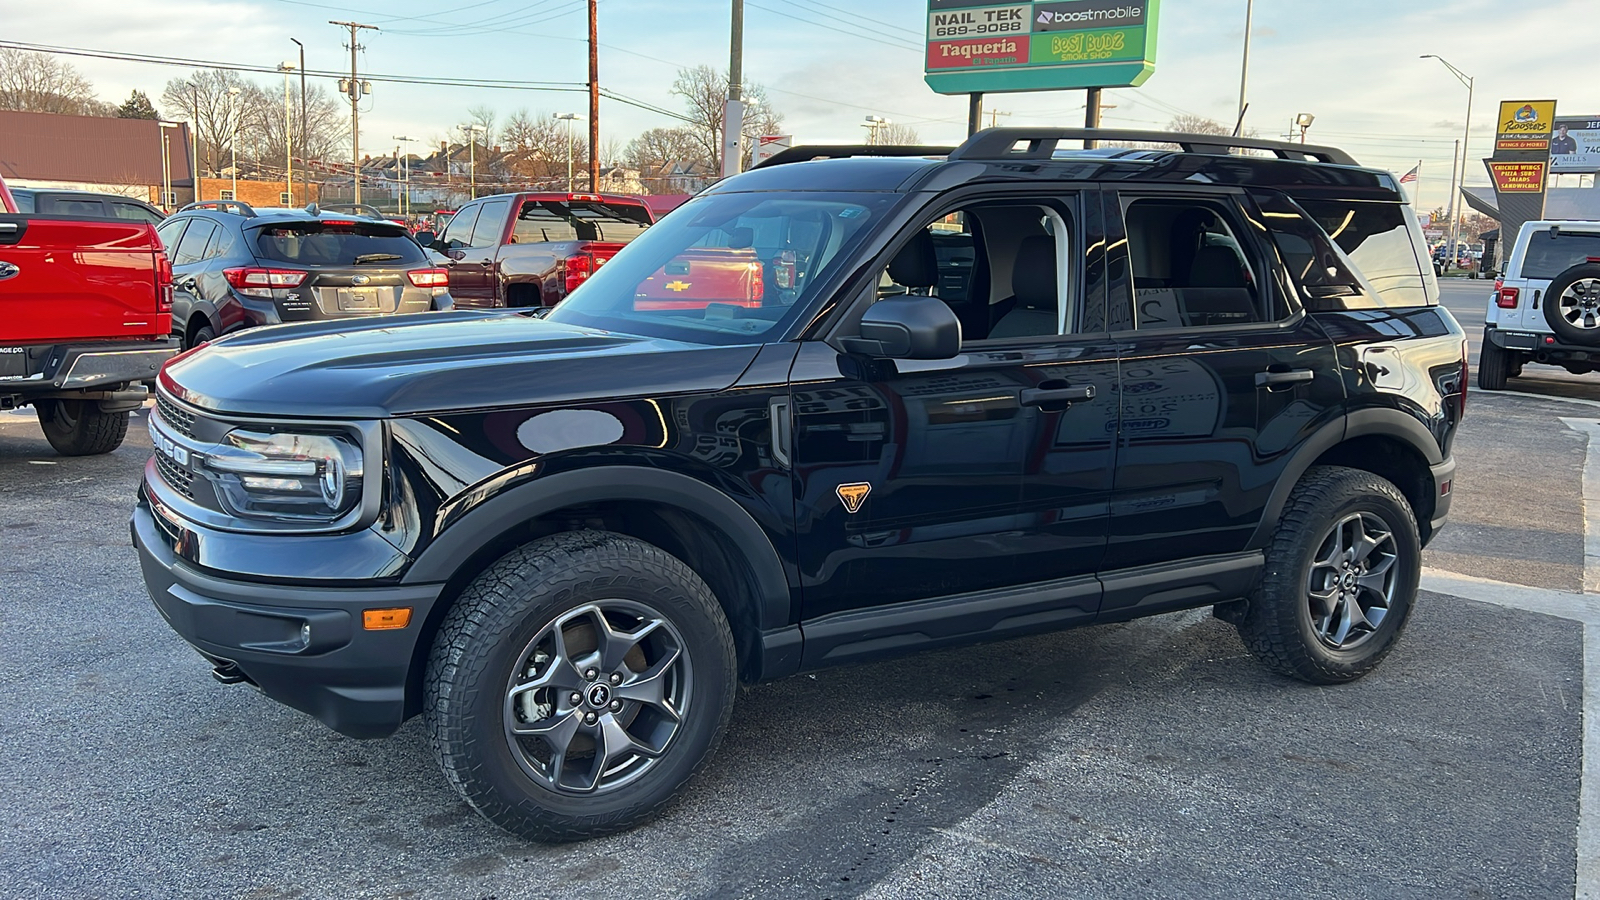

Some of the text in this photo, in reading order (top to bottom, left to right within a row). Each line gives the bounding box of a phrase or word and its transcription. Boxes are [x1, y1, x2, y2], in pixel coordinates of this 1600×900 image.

[934, 8, 1023, 26] NAIL TEK
[936, 21, 1022, 37] 689-9088
[1086, 31, 1125, 52] BUDZ
[1061, 51, 1112, 61] SMOKE SHOP
[1503, 120, 1547, 133] Roosters
